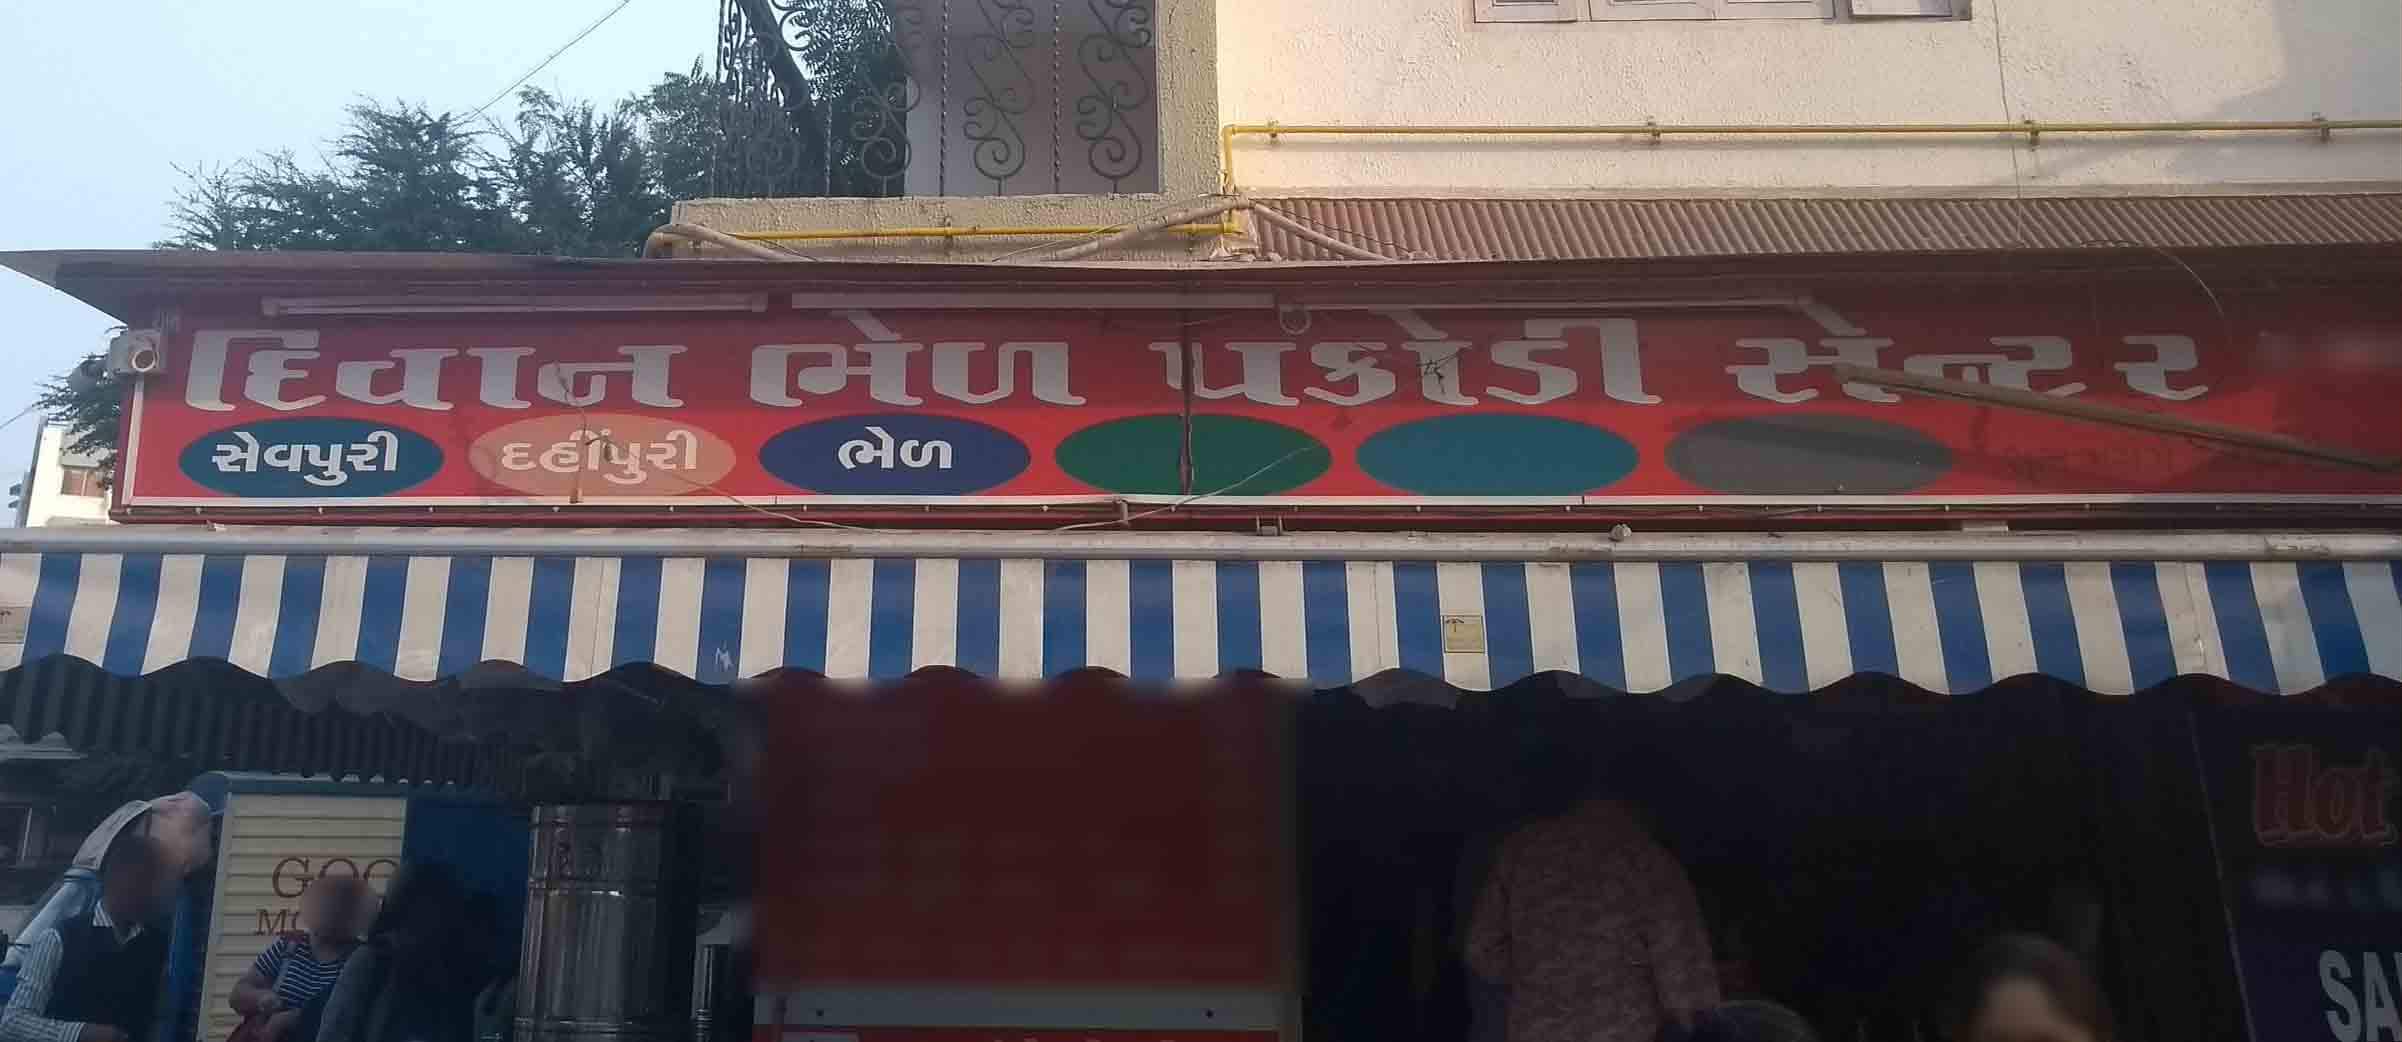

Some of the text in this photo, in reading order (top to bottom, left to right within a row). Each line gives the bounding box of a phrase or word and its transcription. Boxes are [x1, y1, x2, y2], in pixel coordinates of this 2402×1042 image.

[186, 329, 687, 411] દિવાન
[750, 310, 1086, 407] ભેળ
[1149, 309, 1662, 406] પકોડી
[1726, 299, 2208, 404] સેન્ટર
[211, 430, 399, 485] સેવપુરી
[838, 426, 952, 470] ભેળ
[2252, 747, 2396, 846] Hot
[2319, 949, 2402, 1042] SA
